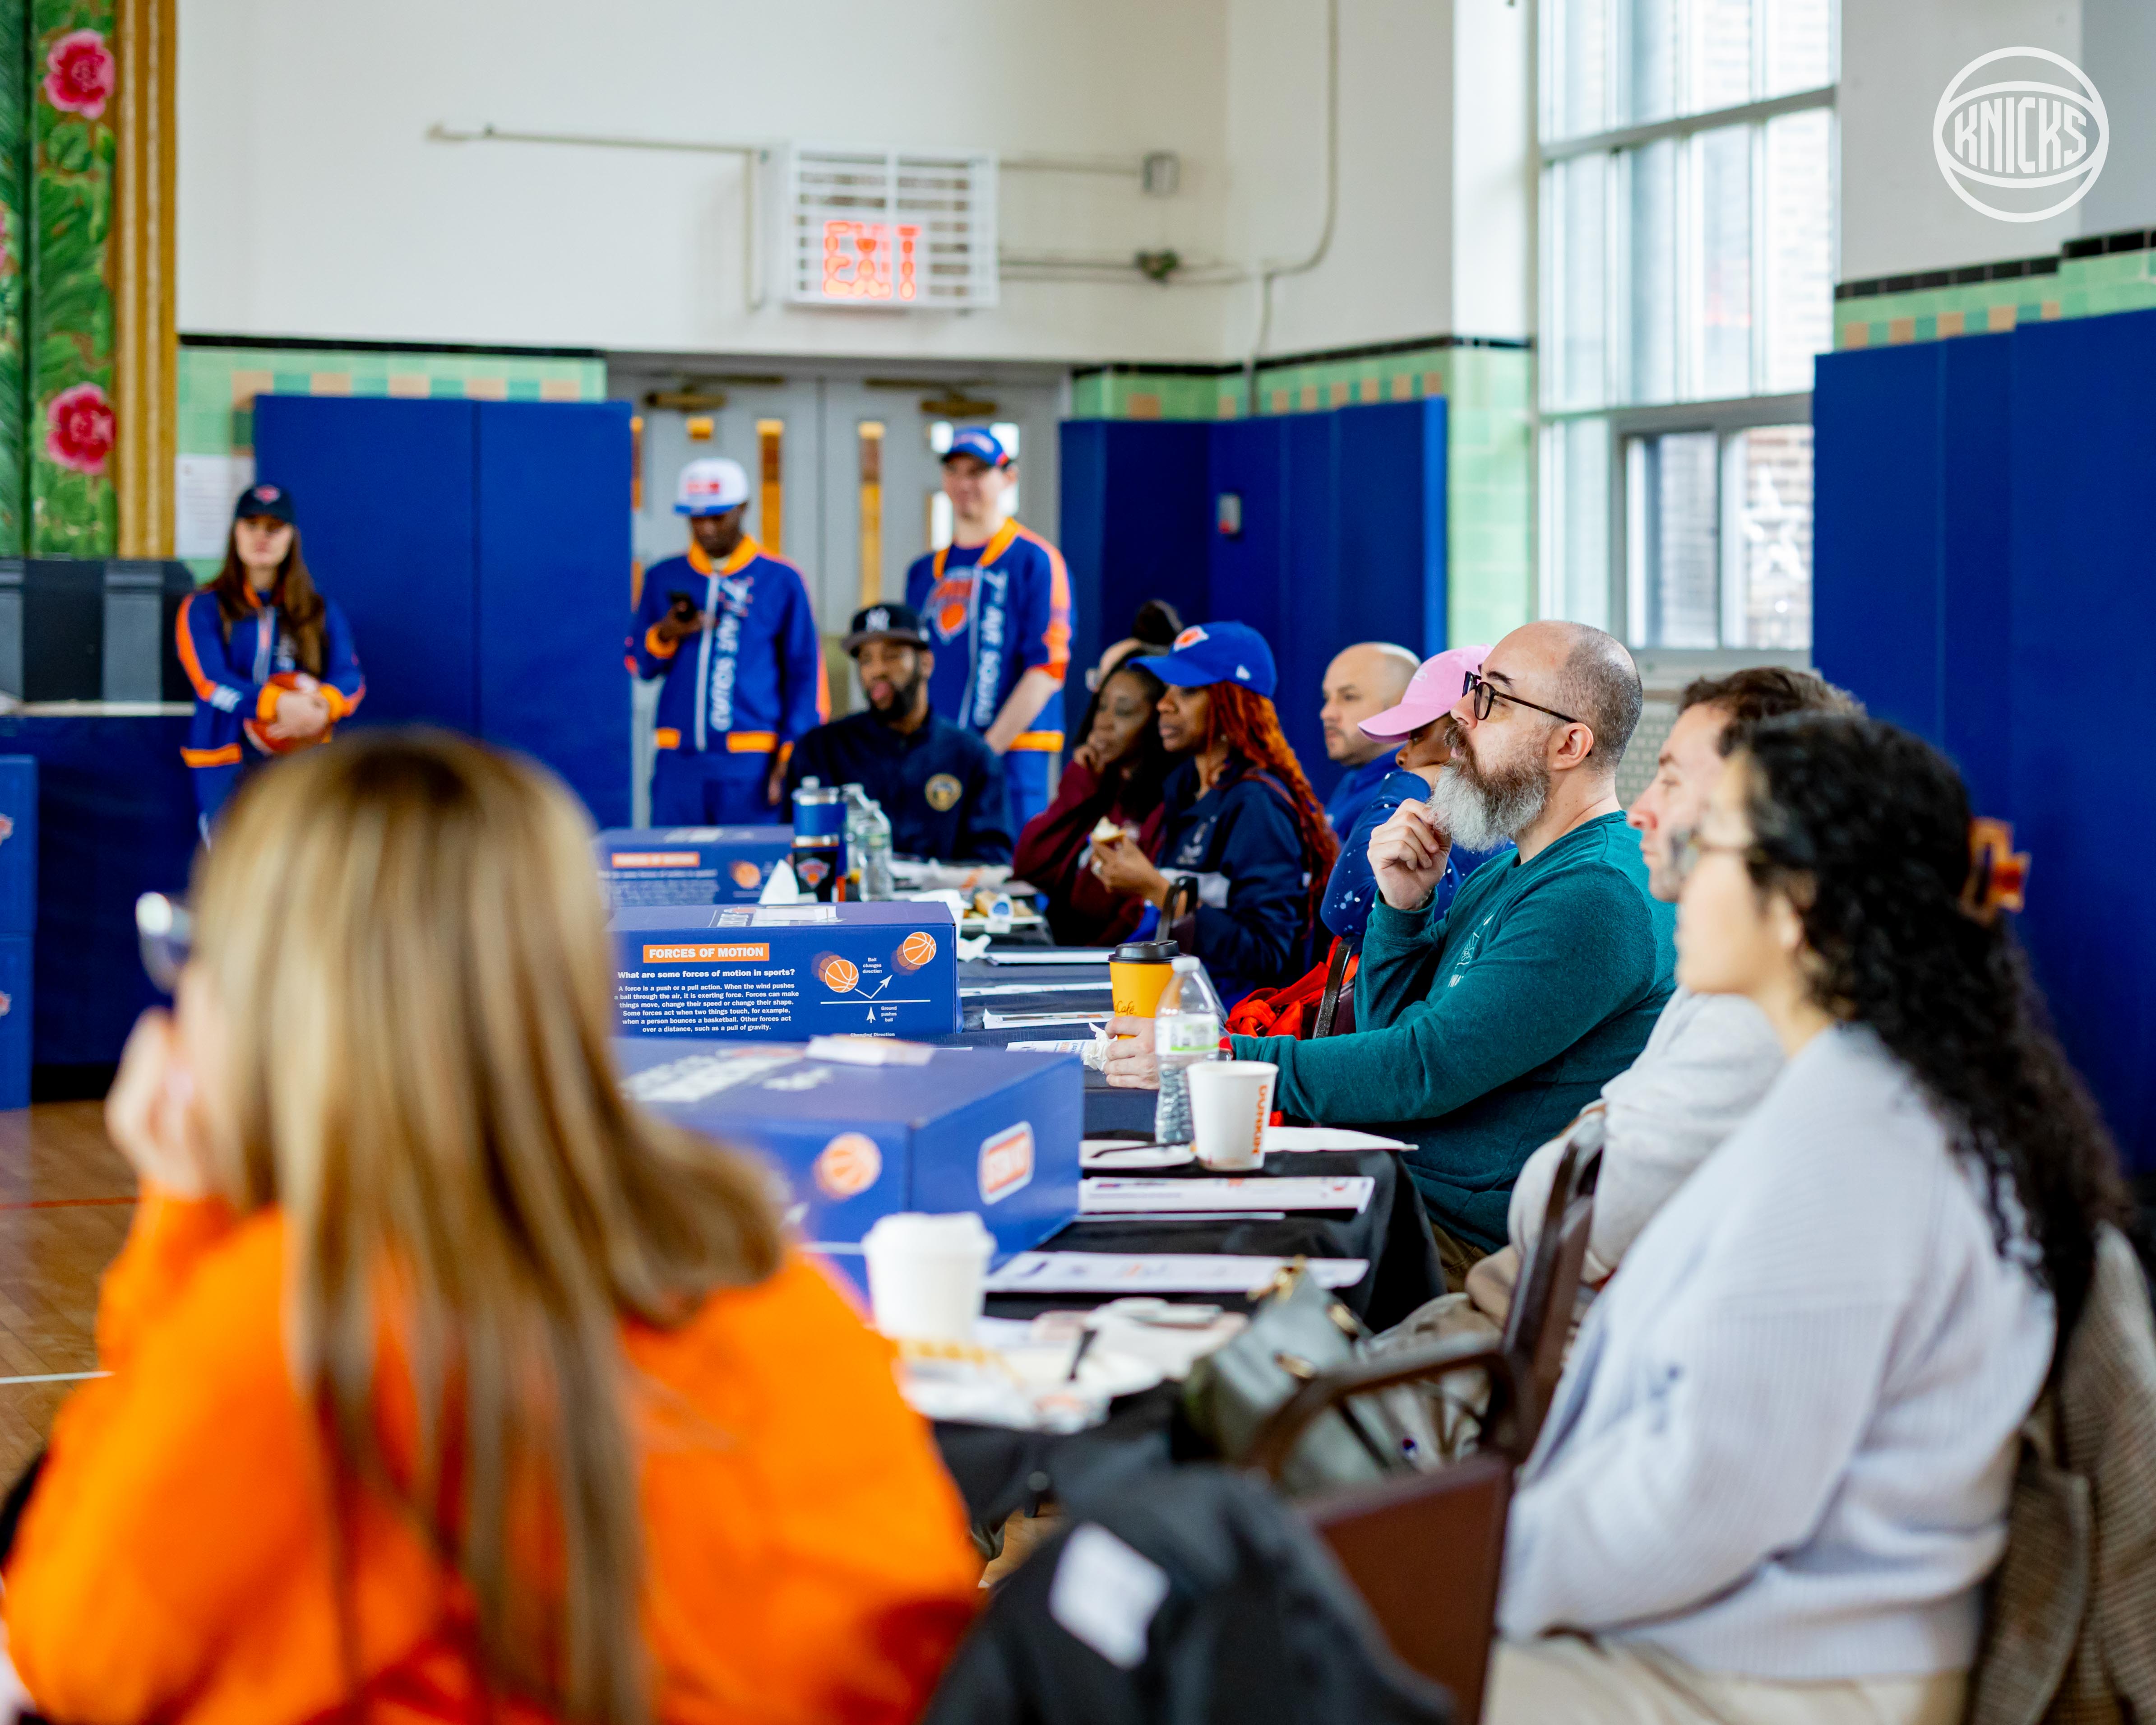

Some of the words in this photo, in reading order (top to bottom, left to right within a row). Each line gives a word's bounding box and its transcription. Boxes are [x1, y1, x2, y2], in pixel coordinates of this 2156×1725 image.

[824, 220, 920, 301] EXIT
[649, 948, 696, 958] FORCES
[699, 948, 715, 957] OF
[718, 947, 763, 957] MOTION
[764, 969, 795, 977] sports?
